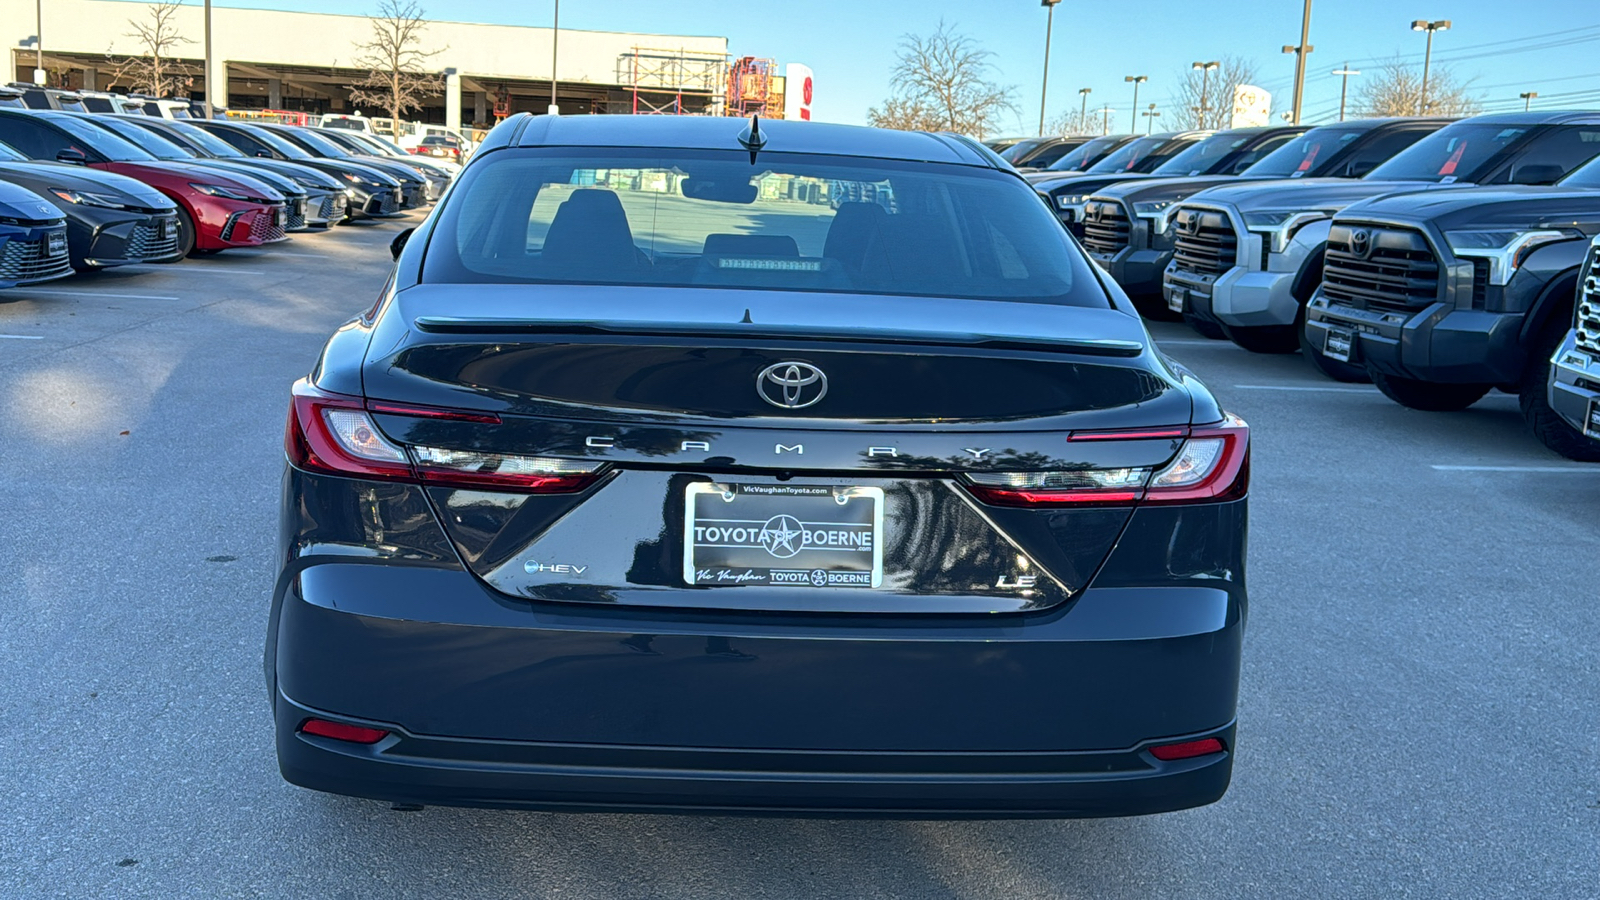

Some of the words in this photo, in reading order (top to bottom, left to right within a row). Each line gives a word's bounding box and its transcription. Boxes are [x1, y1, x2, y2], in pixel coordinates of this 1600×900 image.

[585, 435, 992, 459] CAMRY
[743, 485, 828, 495] VicVaughanToyota.com
[695, 527, 771, 543] TOYOTA
[803, 530, 872, 546] BOERNE
[538, 563, 588, 574] HEV
[696, 569, 714, 582] Vic
[717, 569, 766, 583] Vaughan
[769, 572, 810, 582] TOYOTA
[828, 574, 871, 583] BOERNE
[995, 575, 1038, 588] LE
